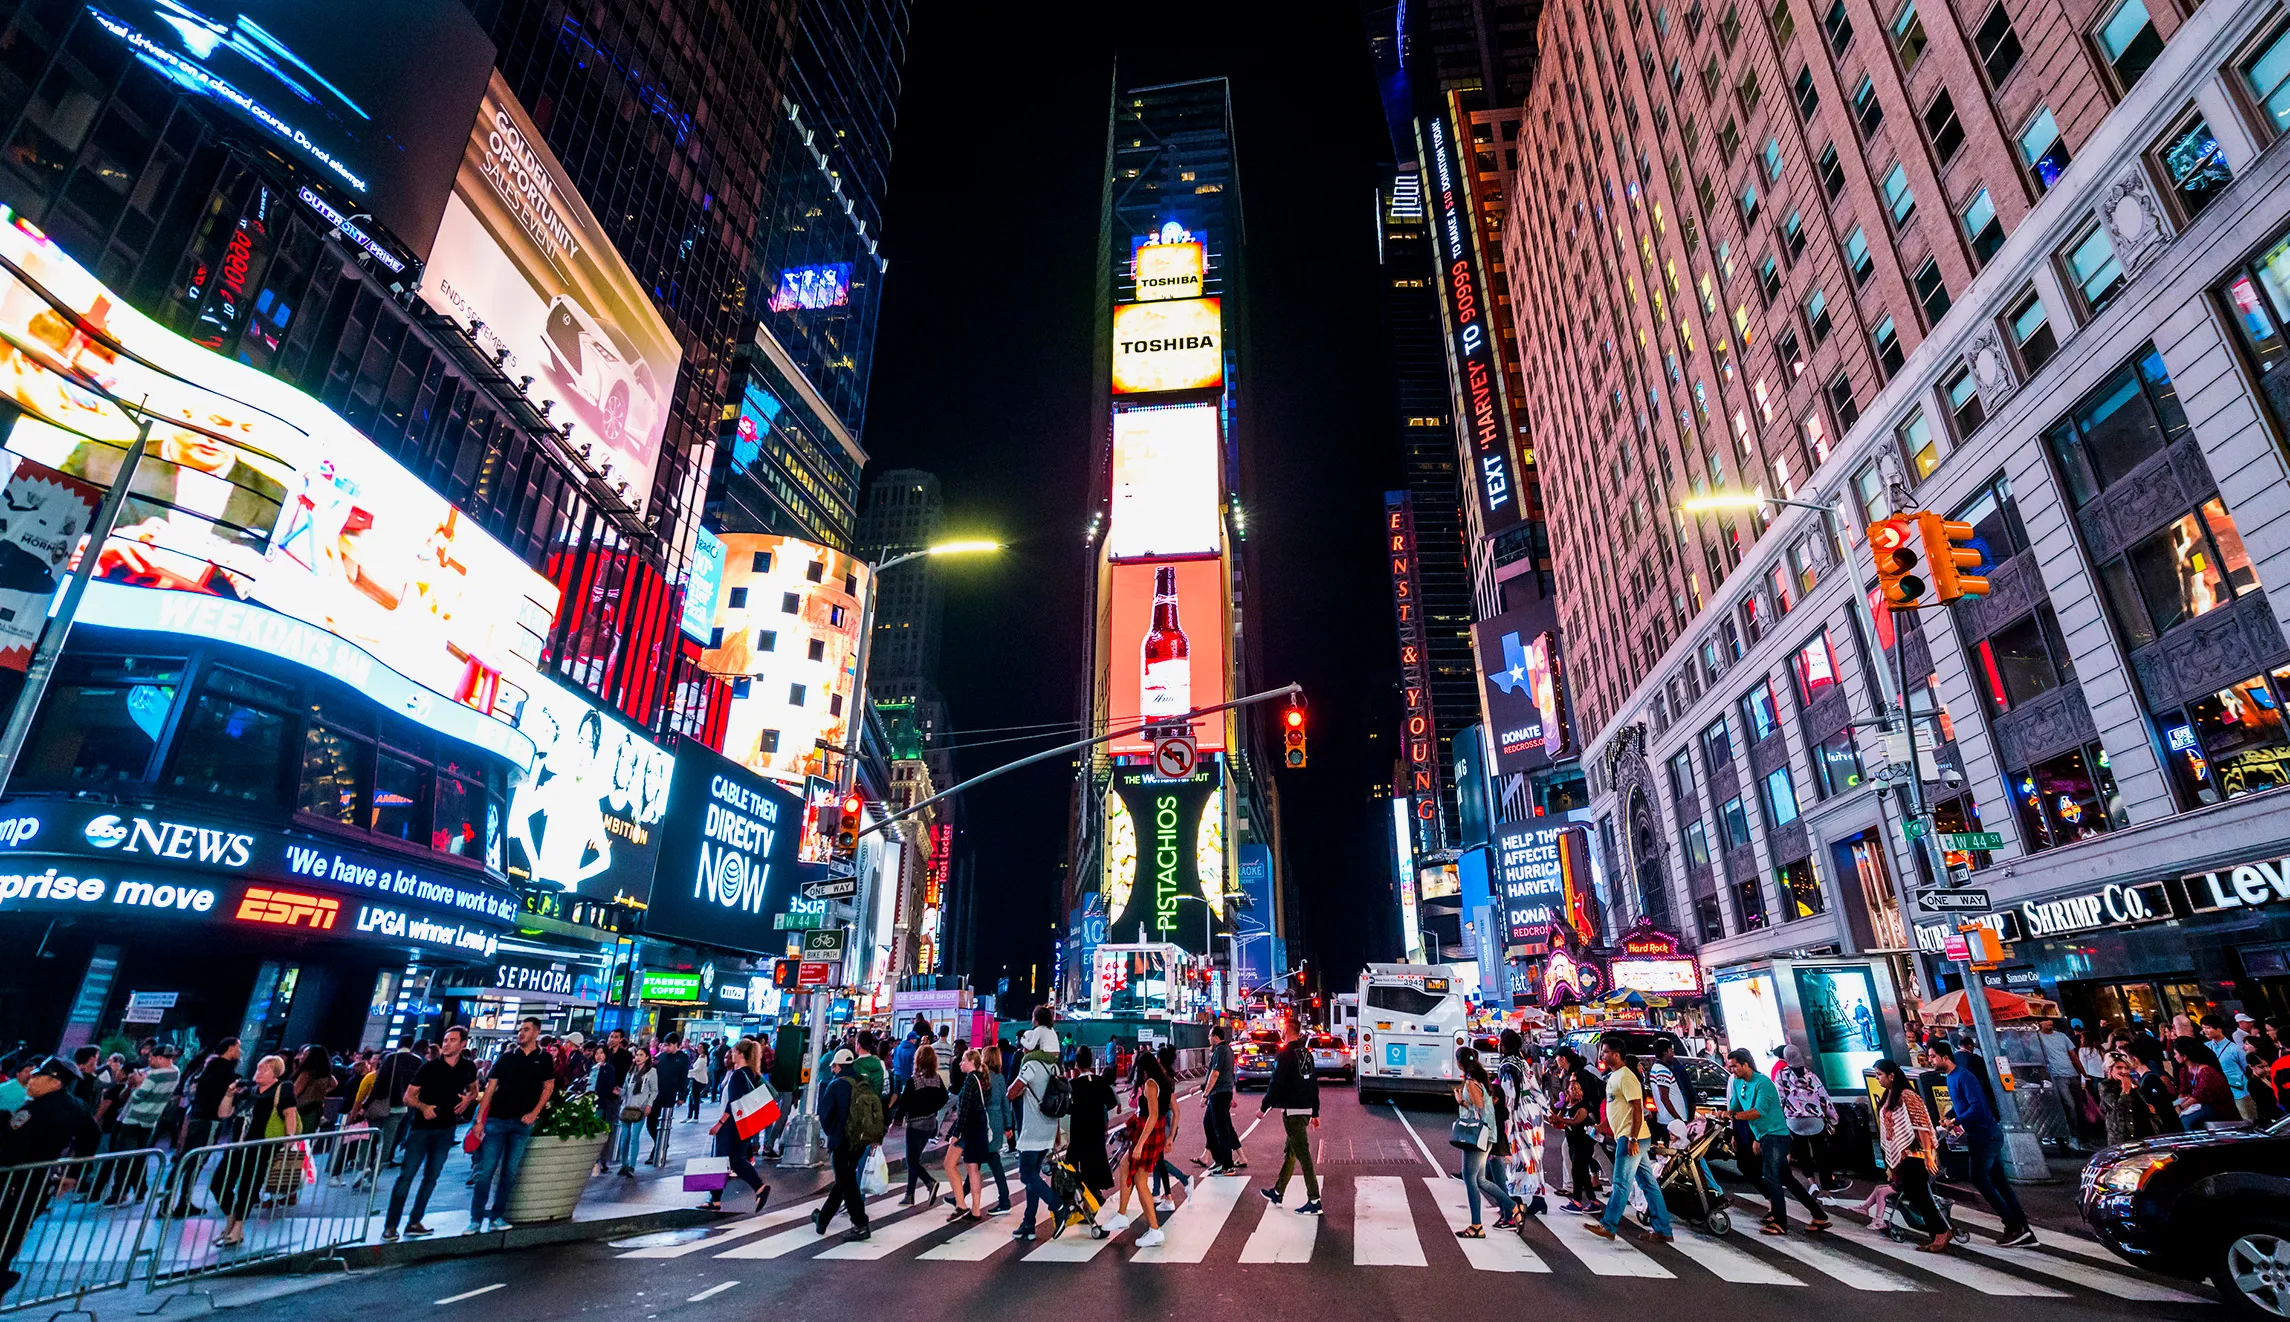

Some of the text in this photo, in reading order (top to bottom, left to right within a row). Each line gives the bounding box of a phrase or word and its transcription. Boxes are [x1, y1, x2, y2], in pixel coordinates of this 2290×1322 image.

[128, 33, 178, 65] drivers
[179, 61, 198, 76] on
[198, 73, 209, 84] a
[208, 79, 253, 110] closed
[252, 105, 293, 138] course.
[293, 130, 312, 150] Do
[311, 146, 330, 164] not
[328, 159, 366, 193] attempt.
[1431, 117, 1444, 148] TODAY.
[495, 111, 553, 196] GOLDEN
[1435, 146, 1451, 192] DONATION
[483, 151, 559, 259] SALES EVENT
[489, 131, 579, 259] OPPORTUNITY
[1443, 191, 1455, 210] $10
[1446, 207, 1456, 217] A
[302, 190, 400, 270] OUTFRONT PRIME
[1447, 219, 1460, 245] MAKE
[1452, 244, 1461, 260] TO
[1141, 275, 1198, 287] TOSHIBA
[1451, 260, 1477, 324] 90999
[440, 279, 465, 312] ENDS
[510, 356, 518, 368] 5
[1120, 335, 1214, 355] TOSHIBA
[1462, 325, 1482, 356] TO
[1482, 455, 1508, 511] TEXT
[158, 595, 333, 663] WEEKDAYS
[1390, 513, 1434, 820] ERNST & YOUNG
[1501, 725, 1541, 745] DONATE
[1123, 776, 1140, 785] THE
[711, 775, 778, 824] CABLE THEN
[603, 812, 649, 845] MBITION
[705, 802, 775, 858] DIRECTV
[939, 824, 951, 858] Locker
[1501, 832, 1534, 851] HELP
[1956, 834, 2000, 849] W 44 St
[85, 825, 127, 839] abc
[122, 817, 254, 867] NEWS
[330, 856, 377, 887] have
[378, 872, 391, 890] a
[394, 870, 416, 896] lot
[417, 882, 454, 905] more
[456, 890, 487, 912] work
[487, 896, 498, 916] to
[1157, 796, 1177, 930] PISTACHIOS
[1504, 845, 1558, 867] AFFECTE
[694, 841, 771, 915] NOW
[1240, 865, 1262, 877] AOKE
[1506, 860, 1561, 882] HURRICA
[810, 883, 850, 896] ONE WAY
[1507, 878, 1559, 898] HARVEY.
[1927, 895, 1983, 906] ONE WAY
[113, 880, 215, 912] move
[235, 888, 341, 930] ESPN
[356, 906, 405, 938] LPGA
[408, 917, 456, 946] winner
[455, 925, 485, 954] Lewis
[785, 915, 795, 927] W
[798, 915, 810, 926] 44
[1511, 906, 1552, 925] DONAT
[2022, 895, 2102, 937] SHRIMP
[806, 950, 838, 959] BIKE PATH
[1628, 942, 1669, 954] Hard Rock
[496, 964, 572, 994] SEPHORA
[643, 976, 699, 987] STARBUCKS
[651, 986, 686, 996] COFFEE
[895, 992, 957, 1001] ICE CREAM SHOP
[1934, 1089, 1950, 1098] Bea
